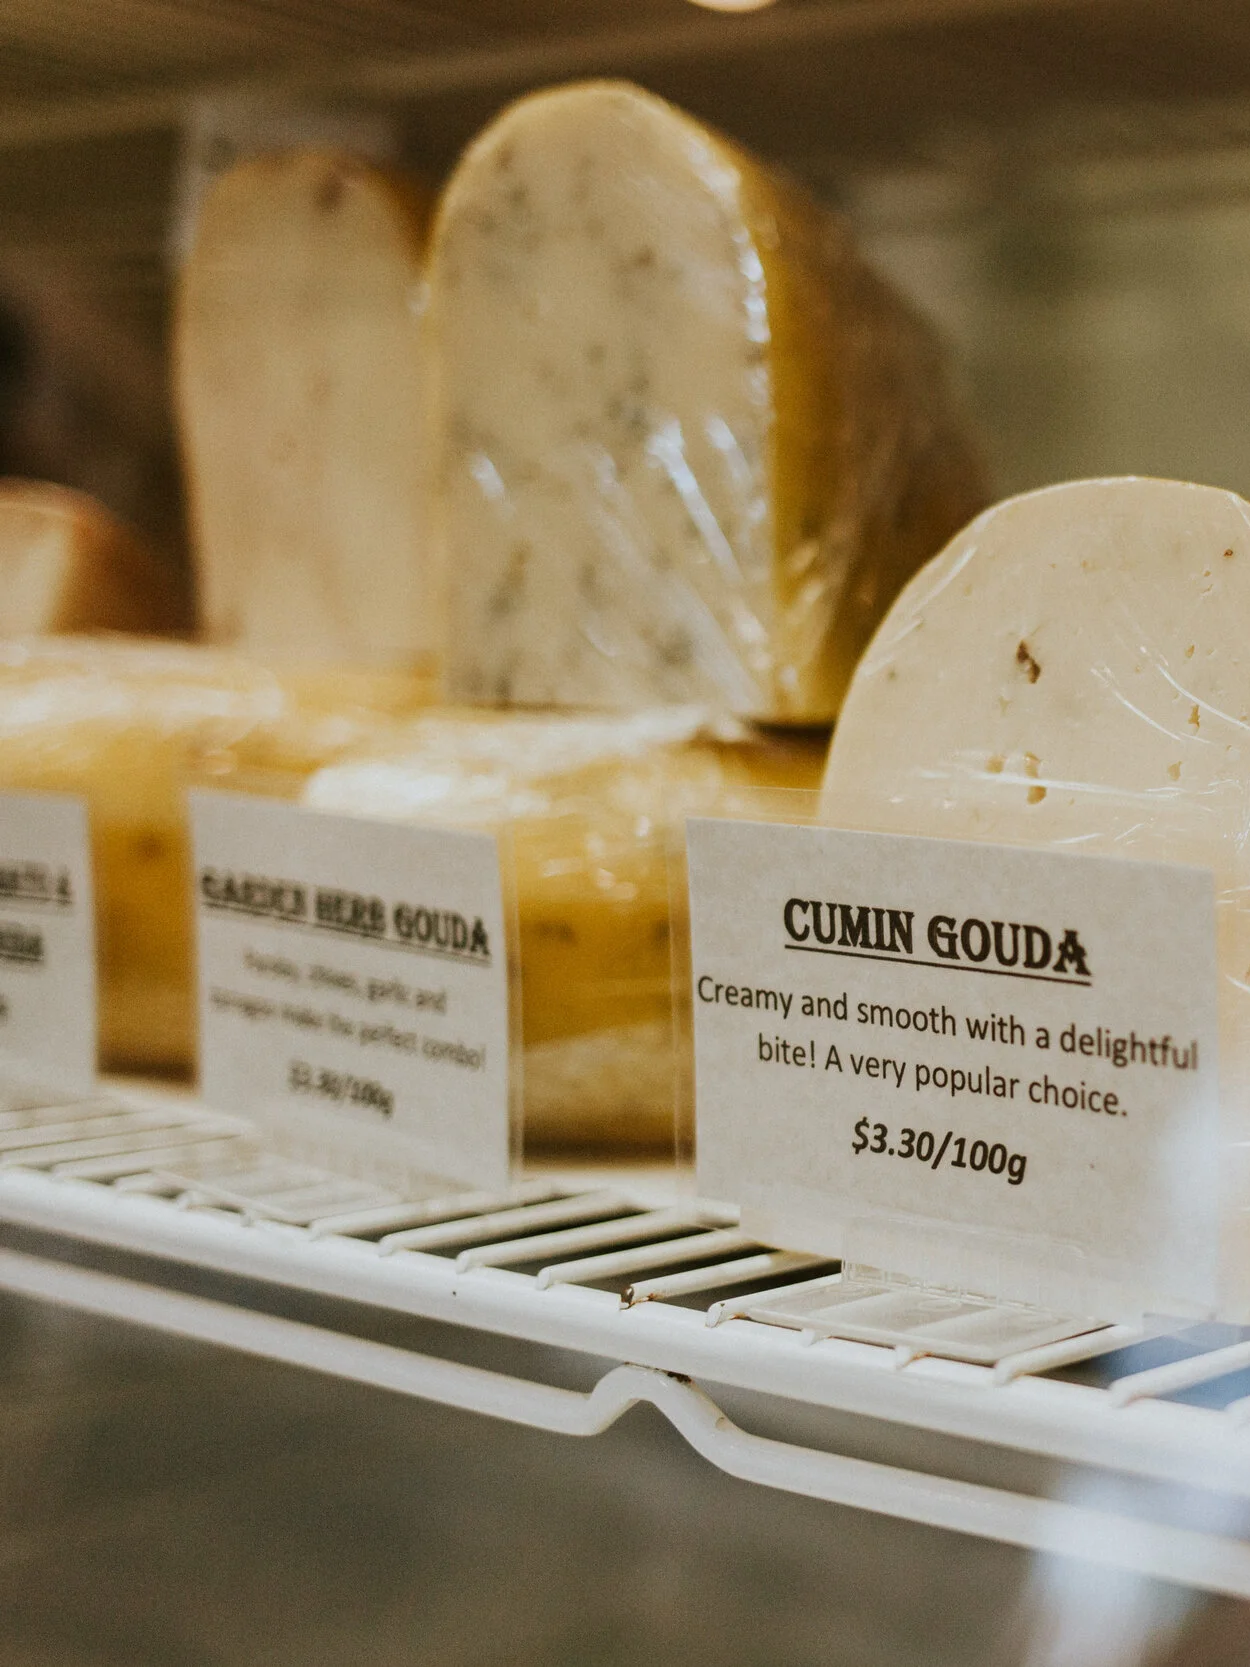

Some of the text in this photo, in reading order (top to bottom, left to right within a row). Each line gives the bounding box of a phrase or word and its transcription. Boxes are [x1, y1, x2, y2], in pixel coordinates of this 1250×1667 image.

[393, 902, 490, 955] GOUDA
[783, 898, 1092, 976] CUMIN GOUDA
[697, 975, 1198, 1071] Creamy and smooth with a delightful
[757, 1033, 1128, 1118] bite! A very popular choice.
[851, 1116, 1027, 1186] $3.30/100g
